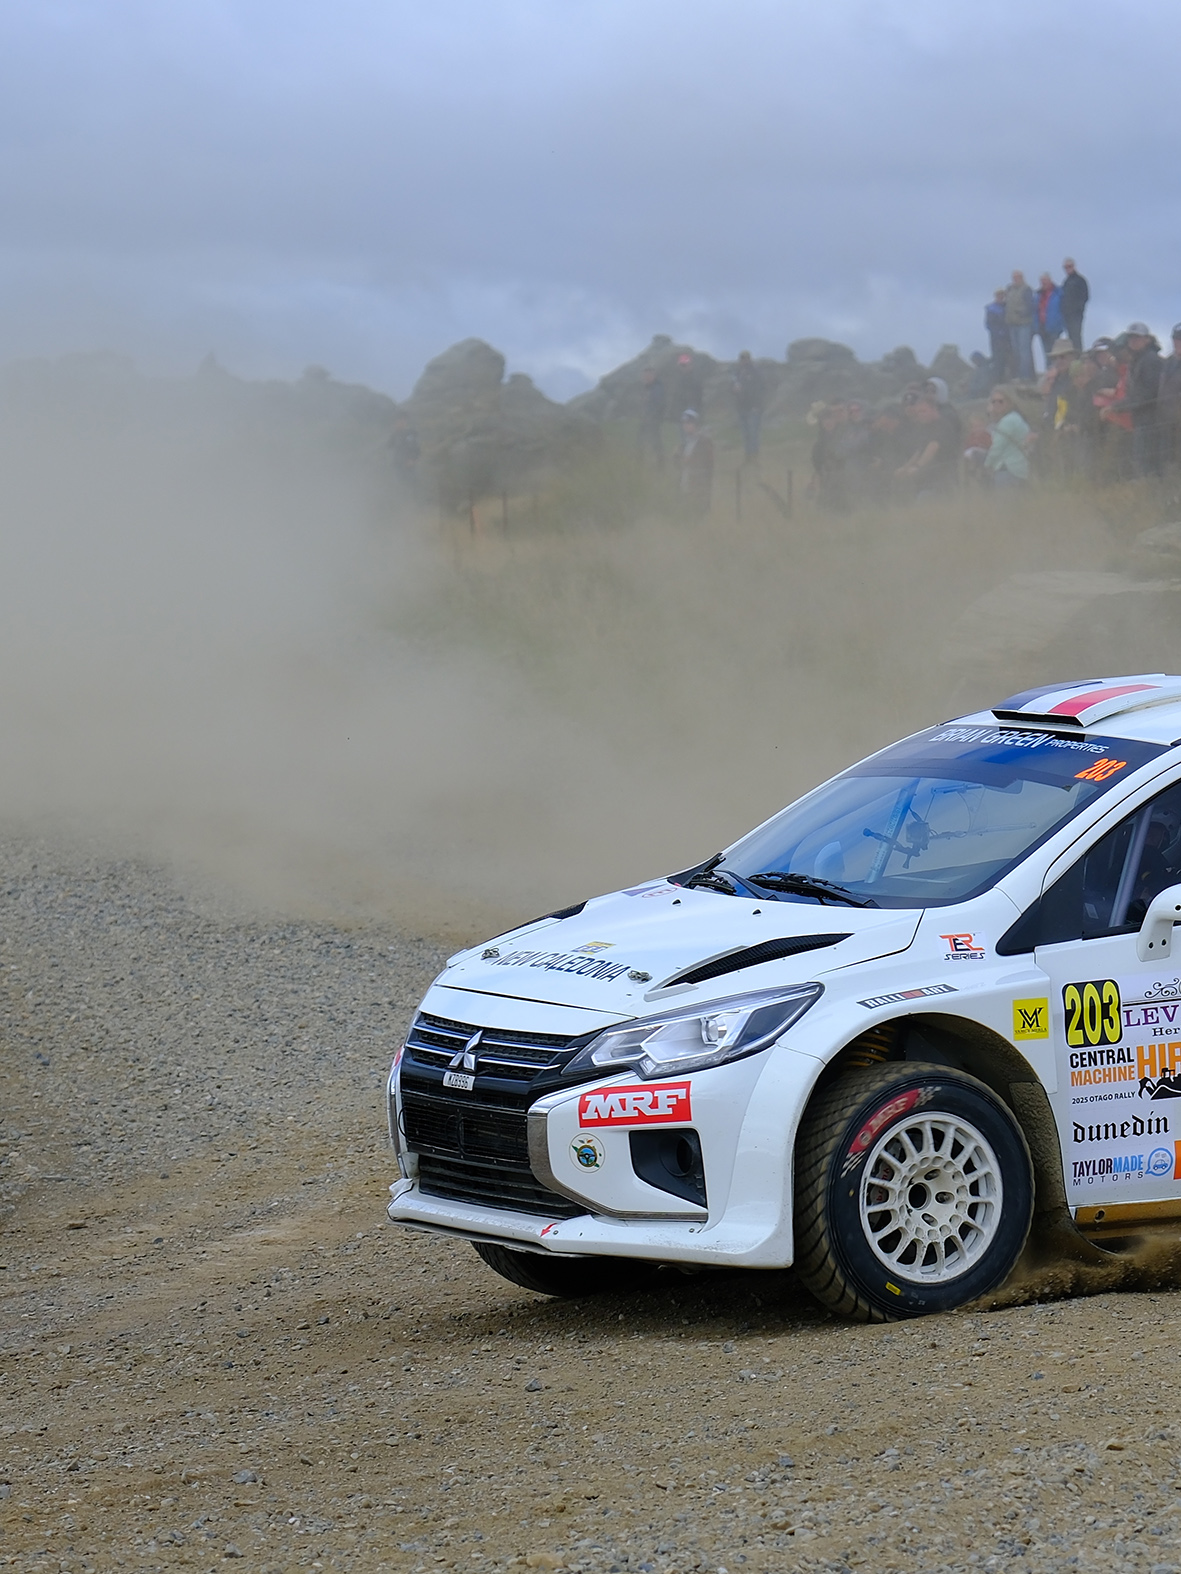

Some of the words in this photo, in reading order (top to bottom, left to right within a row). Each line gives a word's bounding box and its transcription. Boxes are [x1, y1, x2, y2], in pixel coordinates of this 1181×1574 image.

[929, 728, 987, 744] BRIAN
[981, 729, 1052, 749] GREEN
[1045, 737, 1110, 754] PROPERTIES
[1074, 758, 1128, 782] 203
[492, 950, 540, 967] NEW
[529, 952, 632, 983] CALEDONIA
[944, 952, 986, 961] SERIES
[864, 992, 907, 1009] RALLI
[921, 984, 950, 997] ART
[1065, 980, 1121, 1047] 203
[1069, 1047, 1135, 1069] CENTRAL
[1070, 1064, 1136, 1087] MACHINE
[582, 1088, 687, 1120] MRF
[1071, 1096, 1089, 1105] 2025
[1089, 1094, 1114, 1103] OTAGO
[1114, 1090, 1136, 1101] RALLY
[1072, 1111, 1170, 1144] dunedin
[1071, 1154, 1145, 1178] TAYLORMADE
[1072, 1170, 1145, 1187] MOTORS
